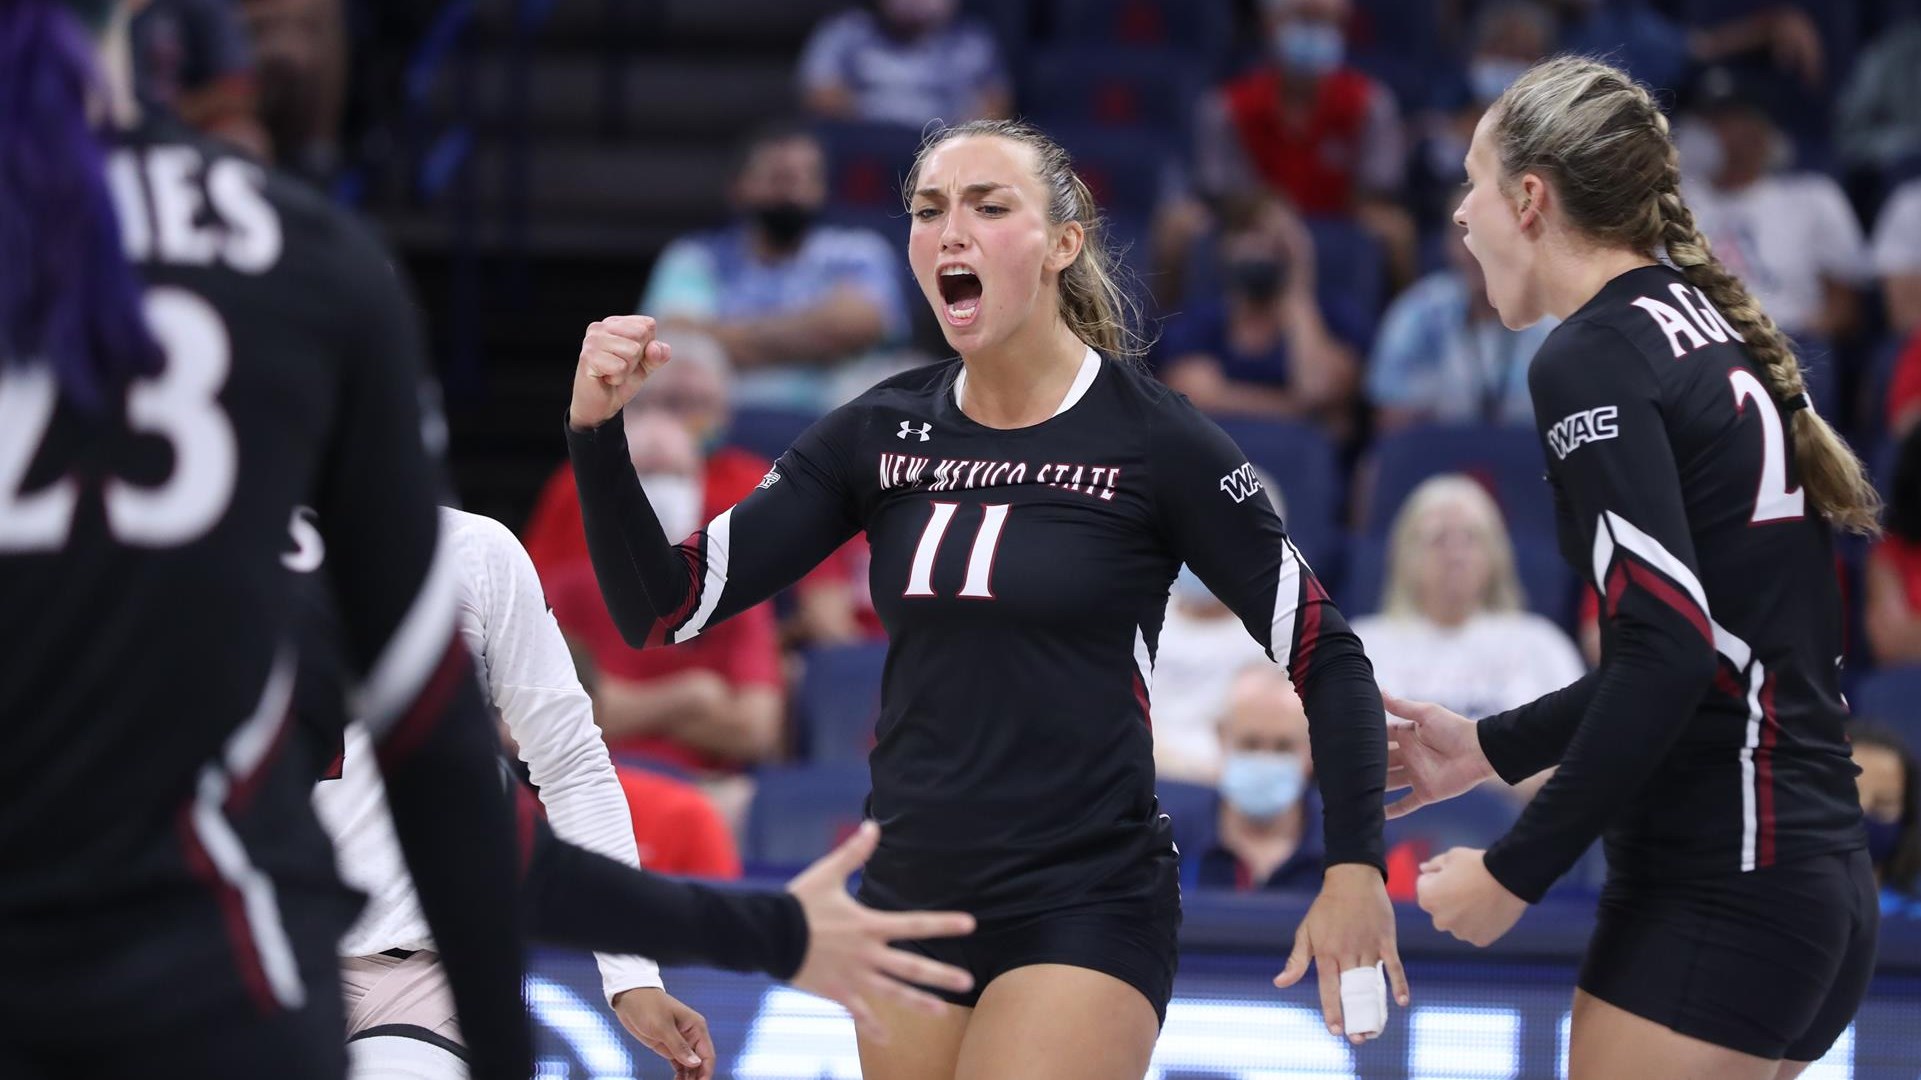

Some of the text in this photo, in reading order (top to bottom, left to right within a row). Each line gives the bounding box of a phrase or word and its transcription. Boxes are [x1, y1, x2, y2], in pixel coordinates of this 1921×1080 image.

[1548, 405, 1619, 460] WAC
[879, 452, 1121, 500] NEW MEXICO STATE
[902, 500, 1014, 599] 11
